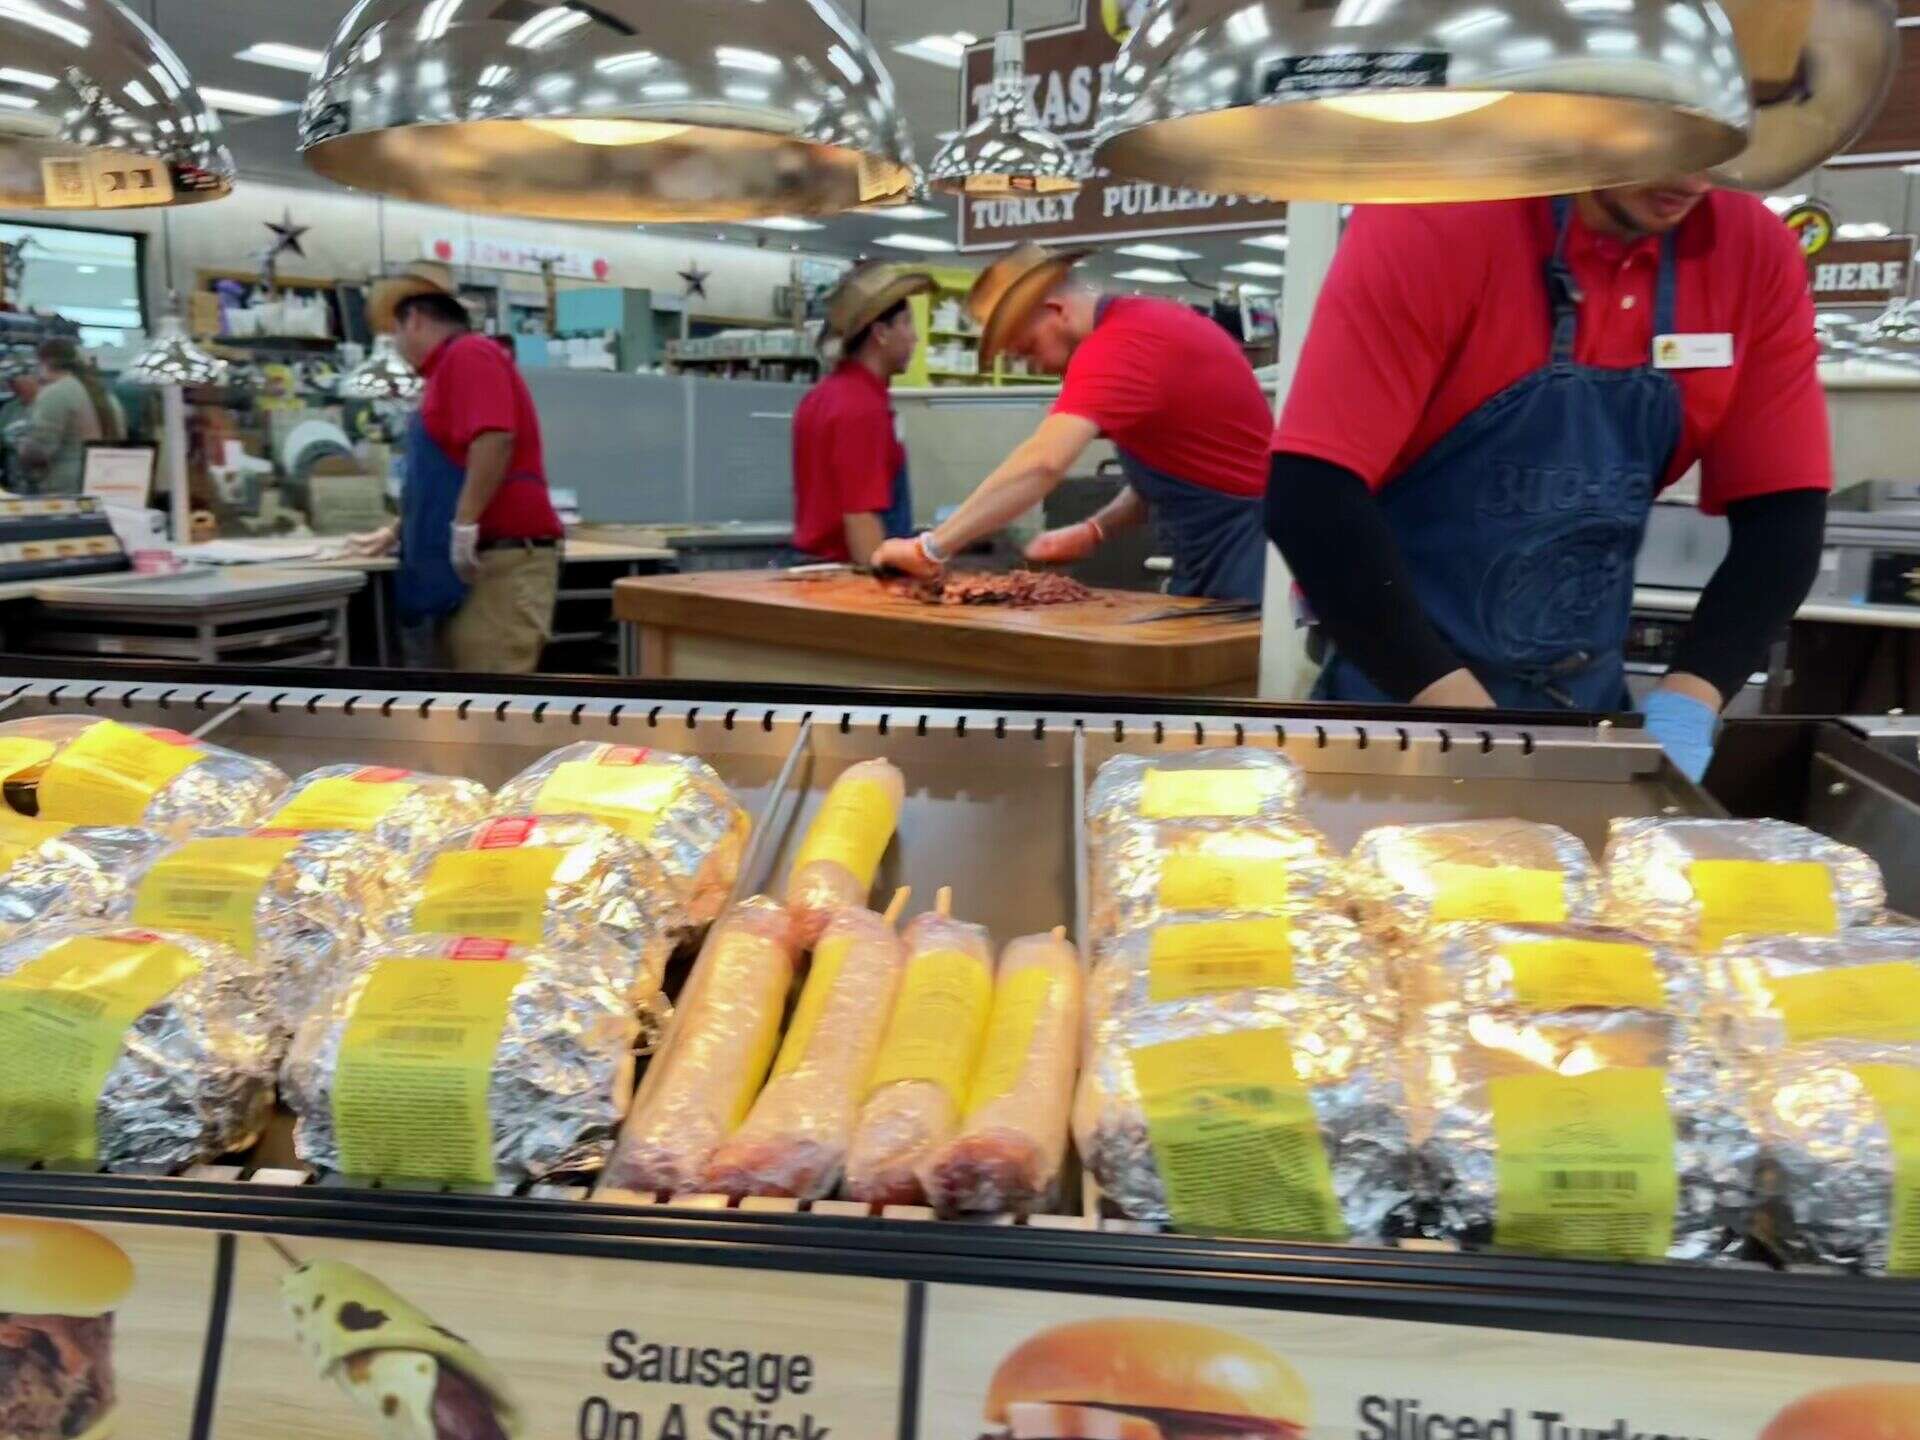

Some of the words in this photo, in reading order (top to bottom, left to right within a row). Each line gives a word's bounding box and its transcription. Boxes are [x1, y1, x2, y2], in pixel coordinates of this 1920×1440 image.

[971, 65, 1092, 129] TXAS
[970, 192, 1080, 229] TURKEY
[1814, 261, 1904, 291] HERE
[605, 1329, 814, 1402] Sausage
[579, 1396, 641, 1440] On
[659, 1402, 688, 1440] A
